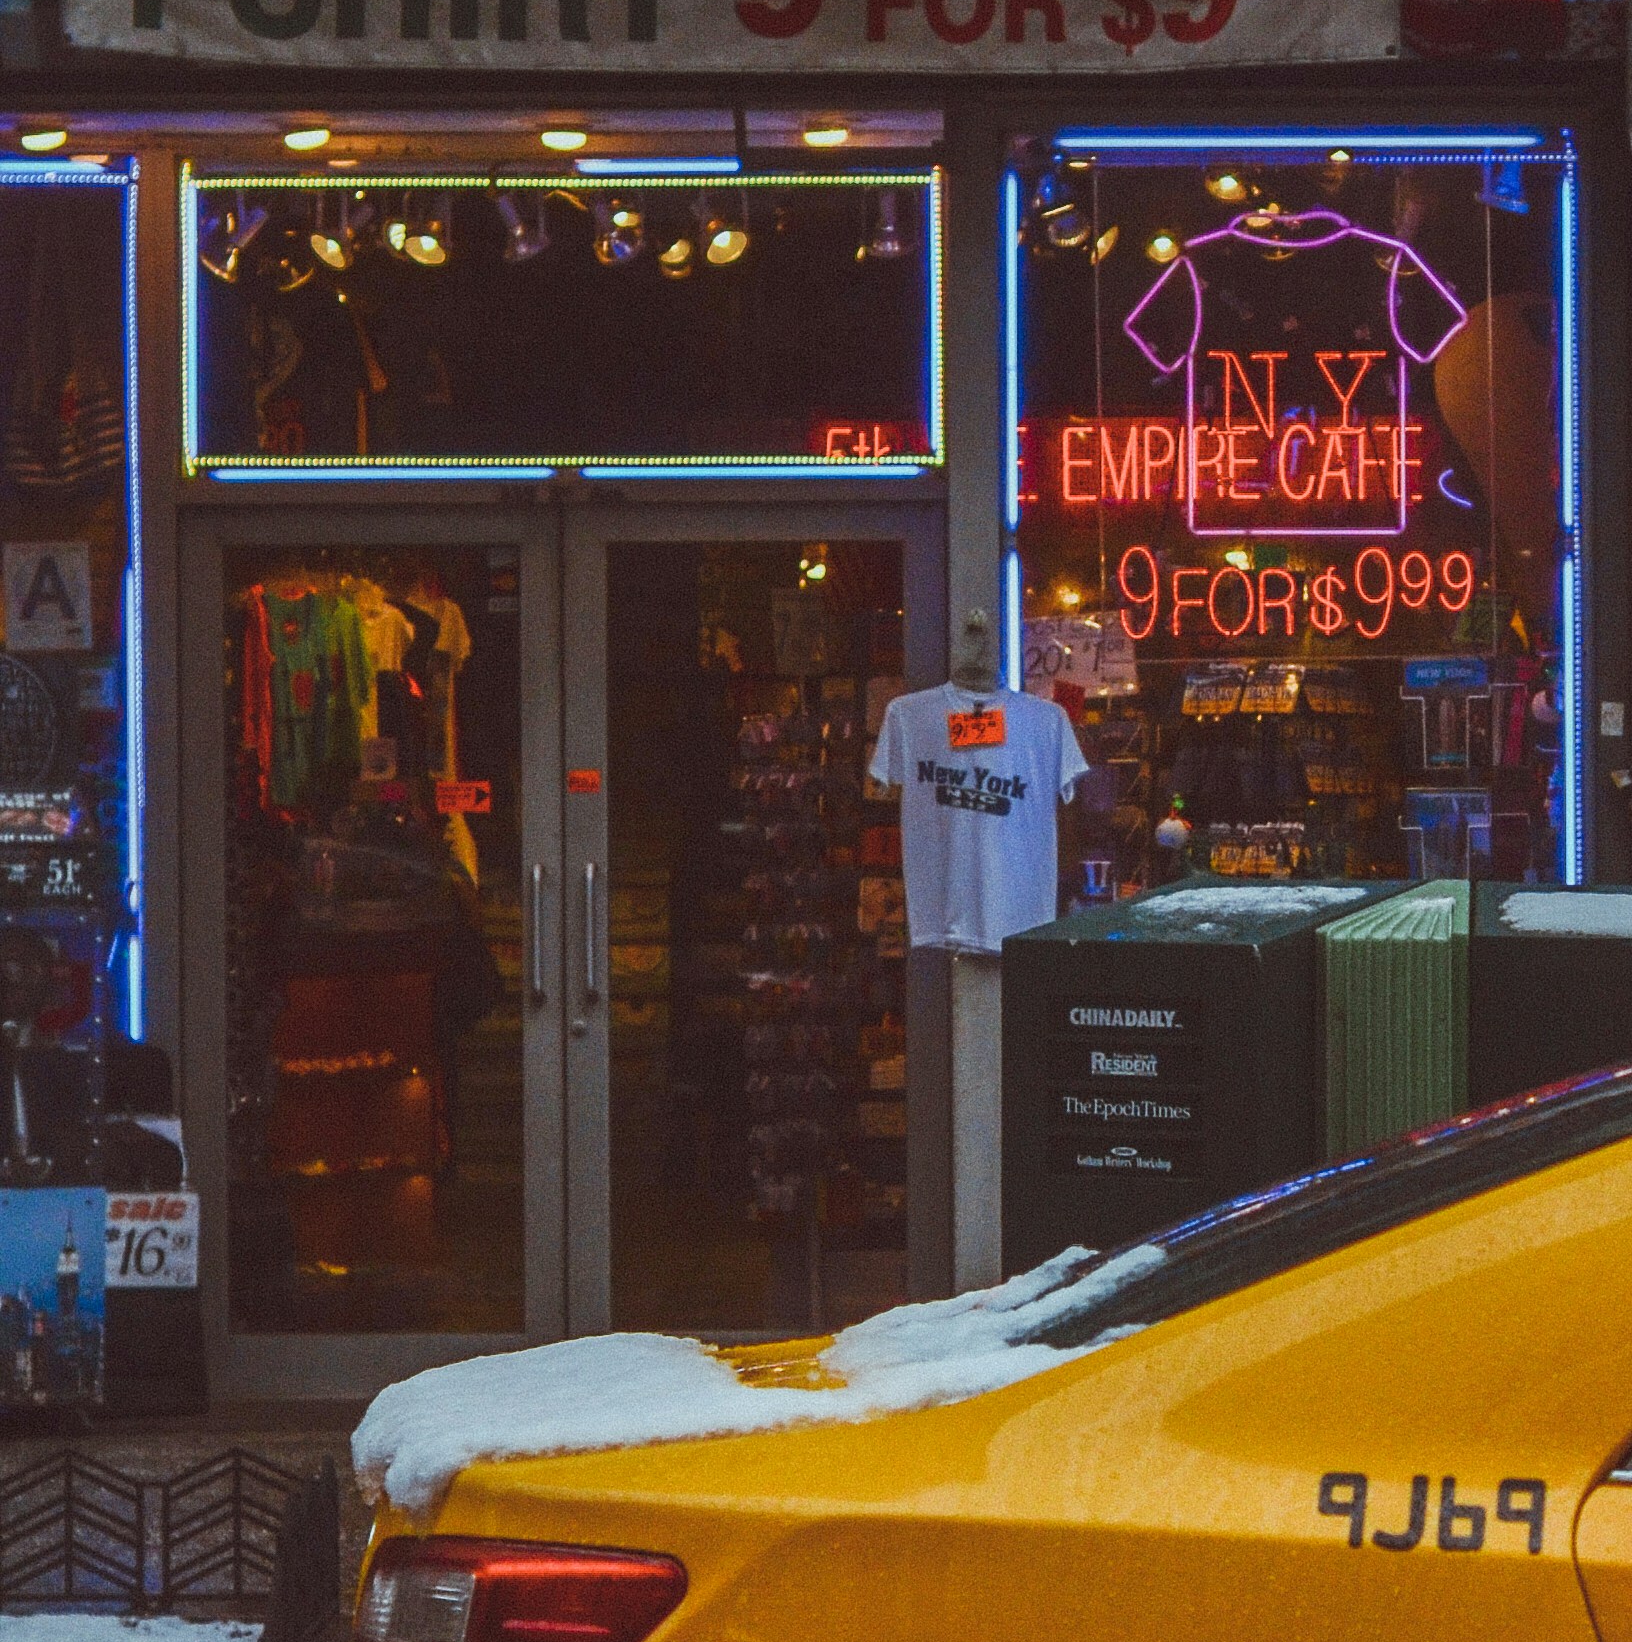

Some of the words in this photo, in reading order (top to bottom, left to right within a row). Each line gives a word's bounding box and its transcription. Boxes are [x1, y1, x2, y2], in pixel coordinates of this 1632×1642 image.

[1063, 425, 1261, 501] EMPIRE
[1278, 423, 1424, 501] CAFE
[19, 554, 77, 621] A
[1118, 544, 1160, 641] 9
[1172, 566, 1297, 637] FOR
[917, 760, 968, 785] New
[973, 767, 1028, 799] York
[43, 884, 82, 895] EACH
[1091, 1051, 1158, 1072] RESIDENT
